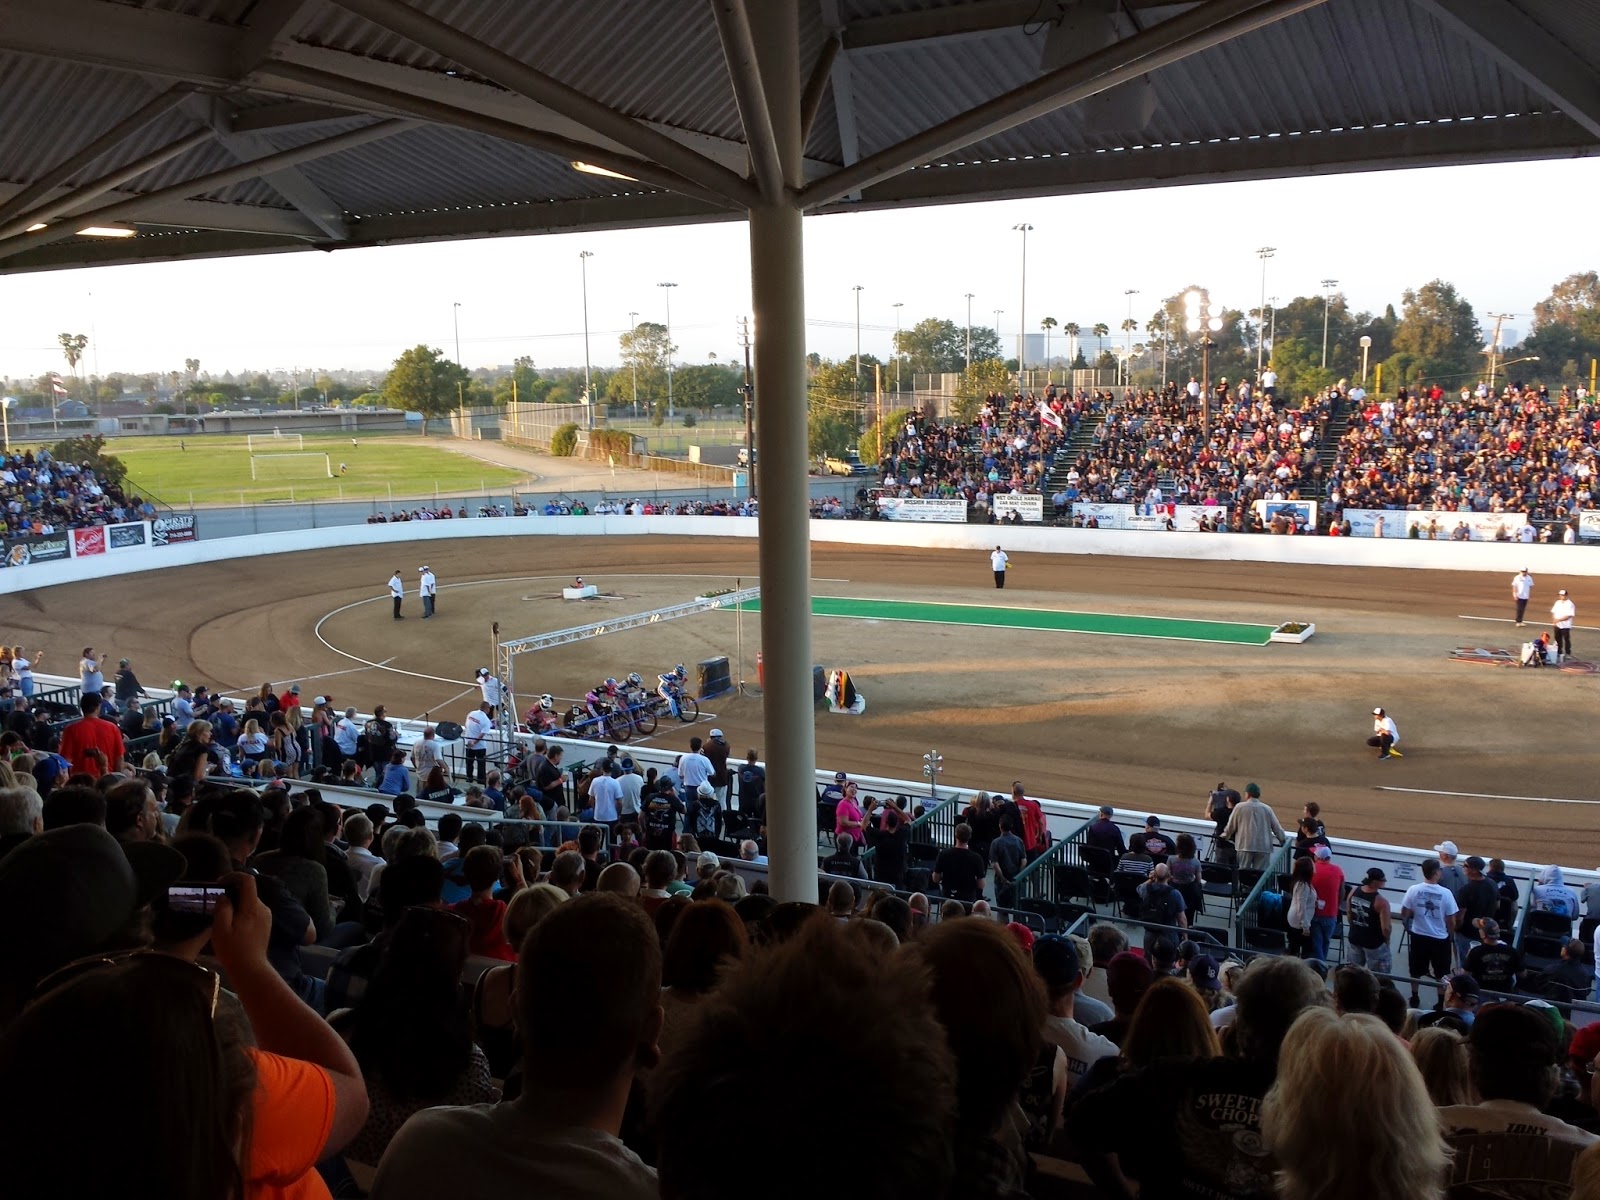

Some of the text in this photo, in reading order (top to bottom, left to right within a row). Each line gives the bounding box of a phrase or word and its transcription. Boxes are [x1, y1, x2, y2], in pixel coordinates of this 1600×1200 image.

[163, 515, 194, 526] PIRATE
[1475, 522, 1514, 530] Kawaki
[1195, 1093, 1260, 1113] SWEET
[1210, 1107, 1261, 1128] CHOP
[1504, 1123, 1548, 1136] TONY
